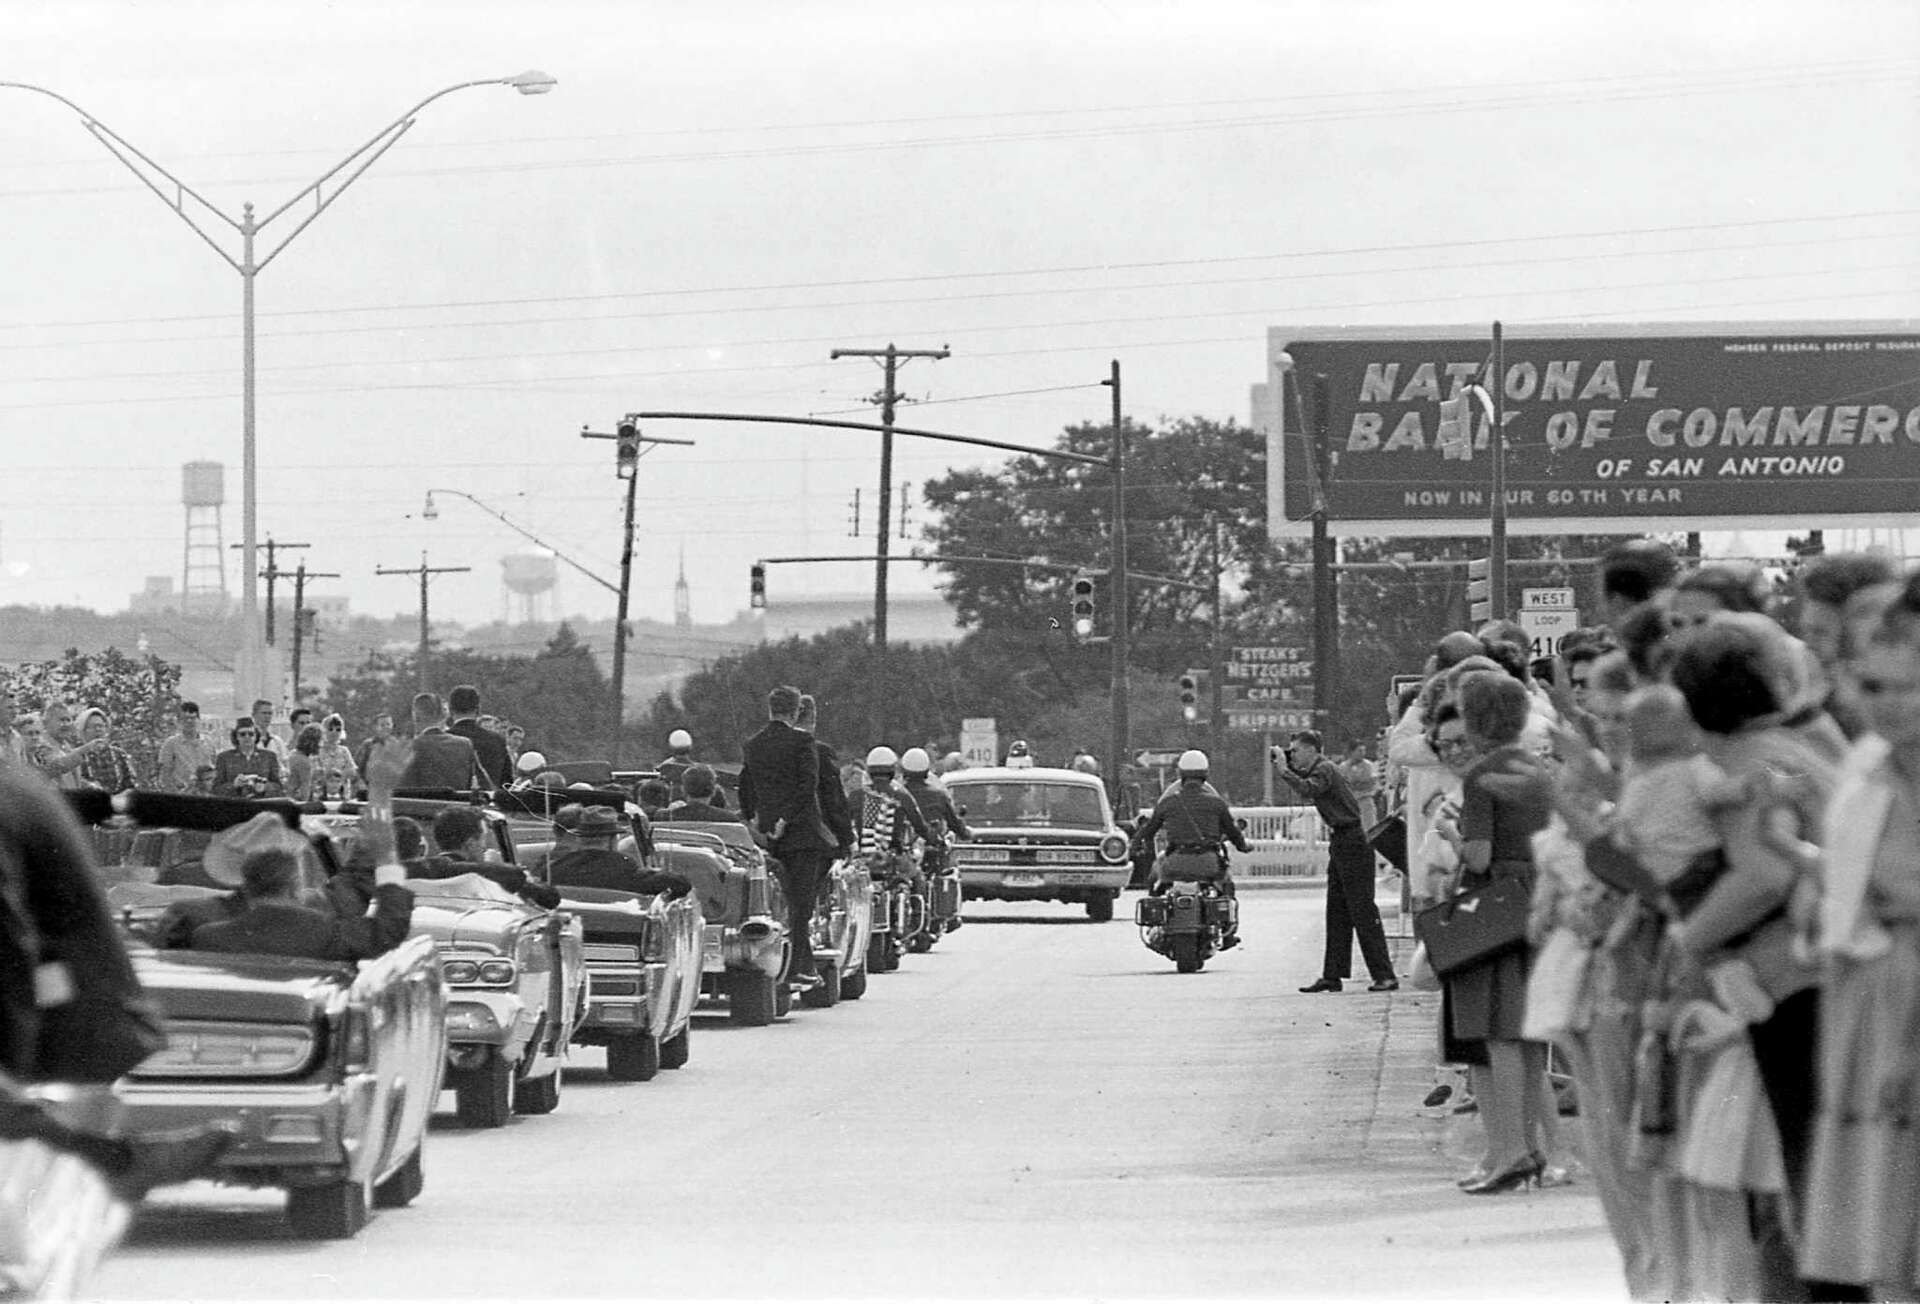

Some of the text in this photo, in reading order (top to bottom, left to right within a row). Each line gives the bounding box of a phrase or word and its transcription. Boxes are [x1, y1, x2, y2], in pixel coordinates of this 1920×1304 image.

[1772, 343, 1820, 352] FEDERAL
[1824, 342, 1871, 351] DEPOSIT
[1347, 411, 1521, 451] BAK
[1546, 410, 1616, 449] OF
[1597, 455, 1845, 478] OF SAN ANTONIO
[1404, 491, 1451, 506] NOW
[1460, 490, 1483, 504] IN
[1491, 490, 1533, 504] UR
[1621, 488, 1683, 502] YEAR
[1531, 593, 1567, 605] WEST
[1534, 615, 1562, 626] LOOP
[1240, 648, 1298, 661] STEAKS
[1247, 688, 1293, 700] CAFE
[966, 748, 992, 762] 410
